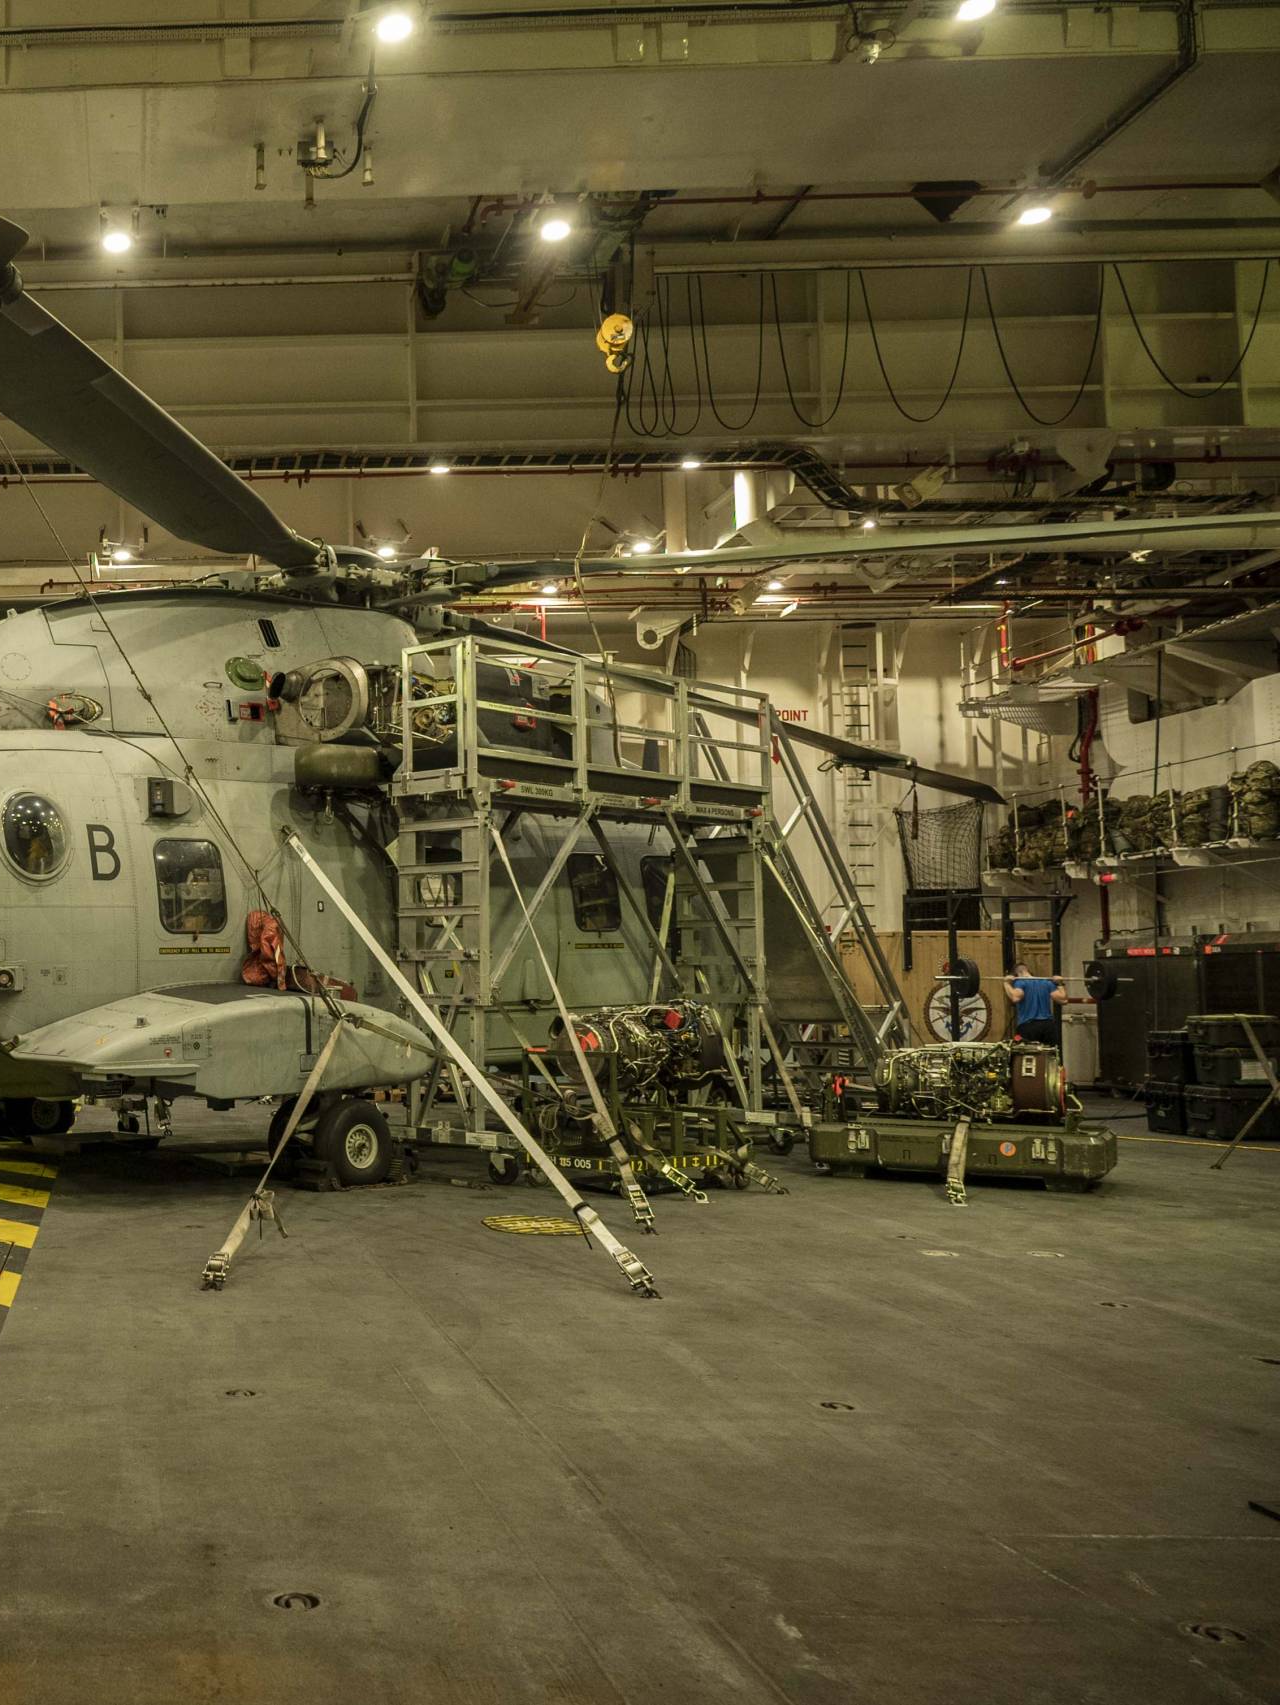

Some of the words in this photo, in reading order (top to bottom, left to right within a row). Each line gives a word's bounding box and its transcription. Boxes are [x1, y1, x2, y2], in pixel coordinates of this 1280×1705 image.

[775, 709, 809, 721] POINT
[85, 823, 121, 881] B
[574, 1158, 592, 1169] 005
